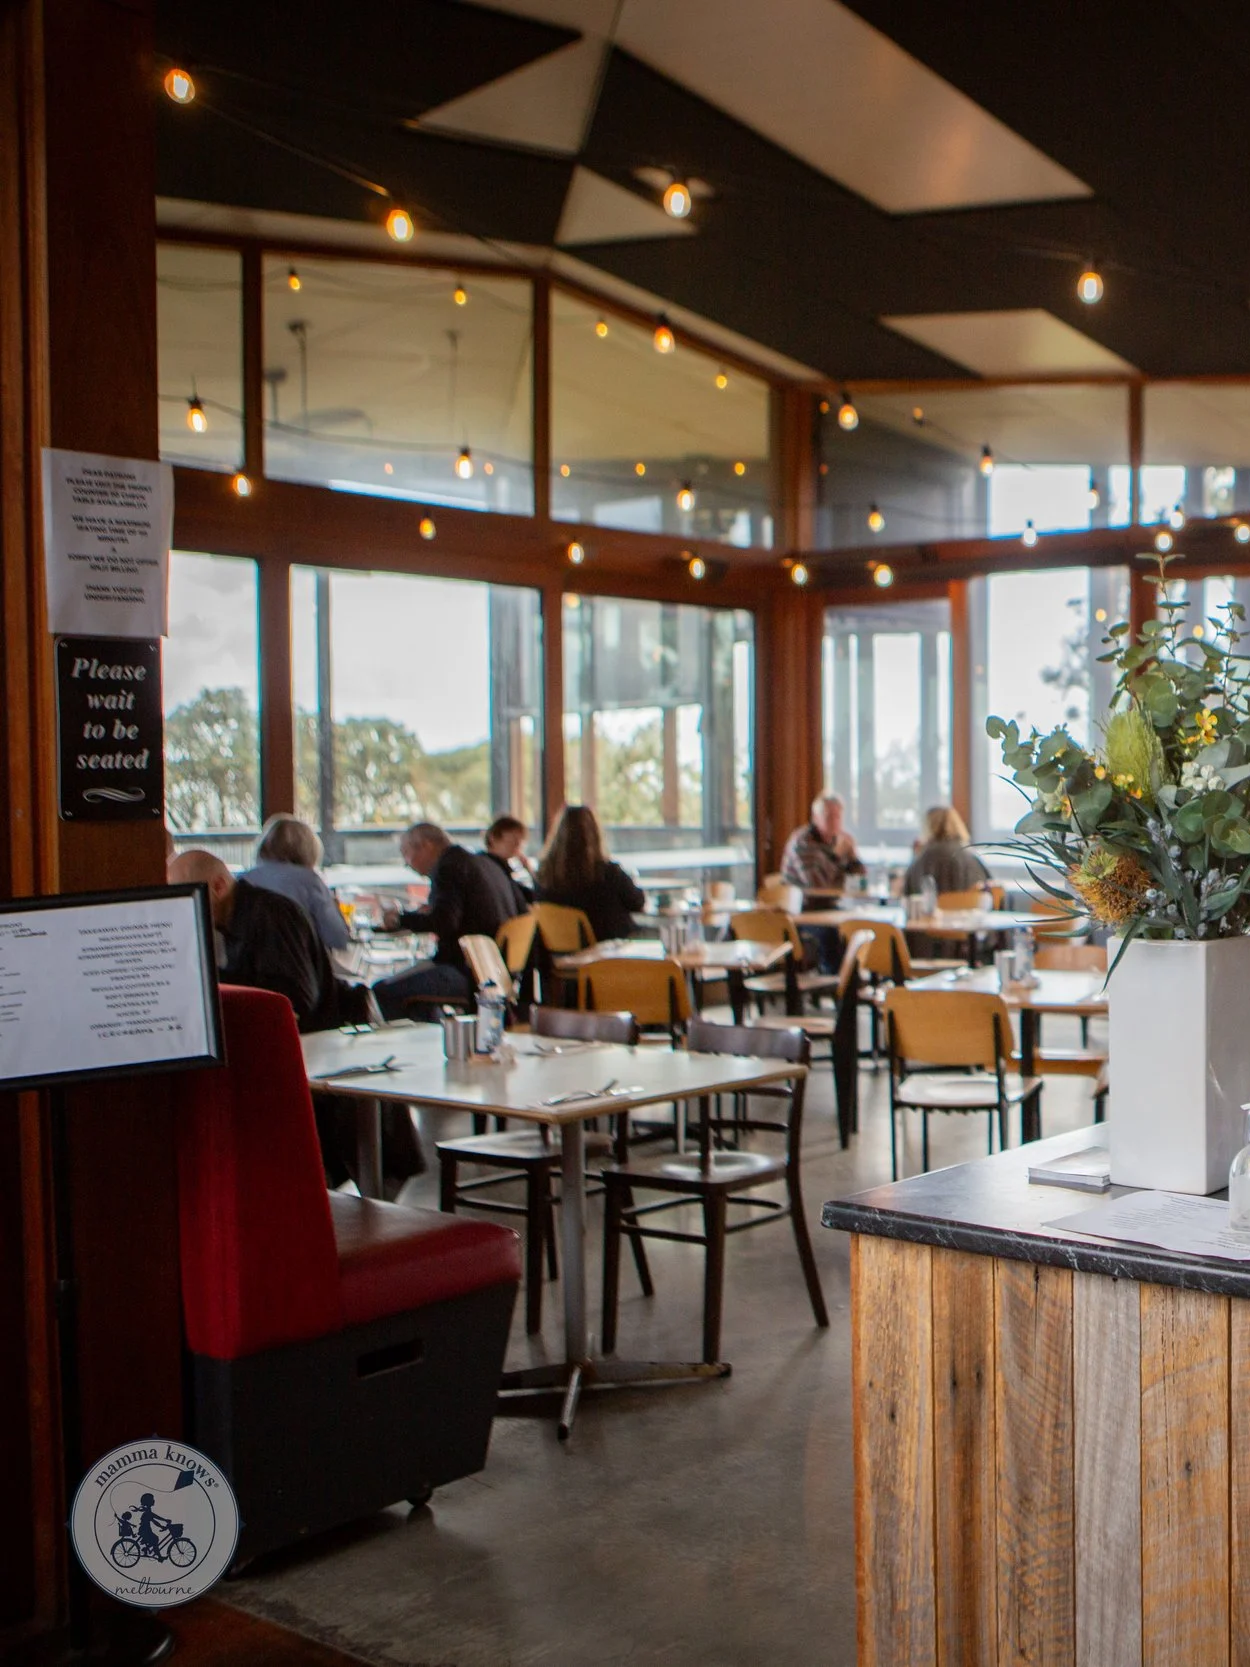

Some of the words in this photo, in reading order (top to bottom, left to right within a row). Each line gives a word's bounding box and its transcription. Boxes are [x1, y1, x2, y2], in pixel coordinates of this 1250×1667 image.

[71, 657, 147, 681] Please
[87, 689, 135, 711] wait
[83, 721, 106, 740] to
[112, 718, 140, 740] be
[76, 749, 150, 769] seated
